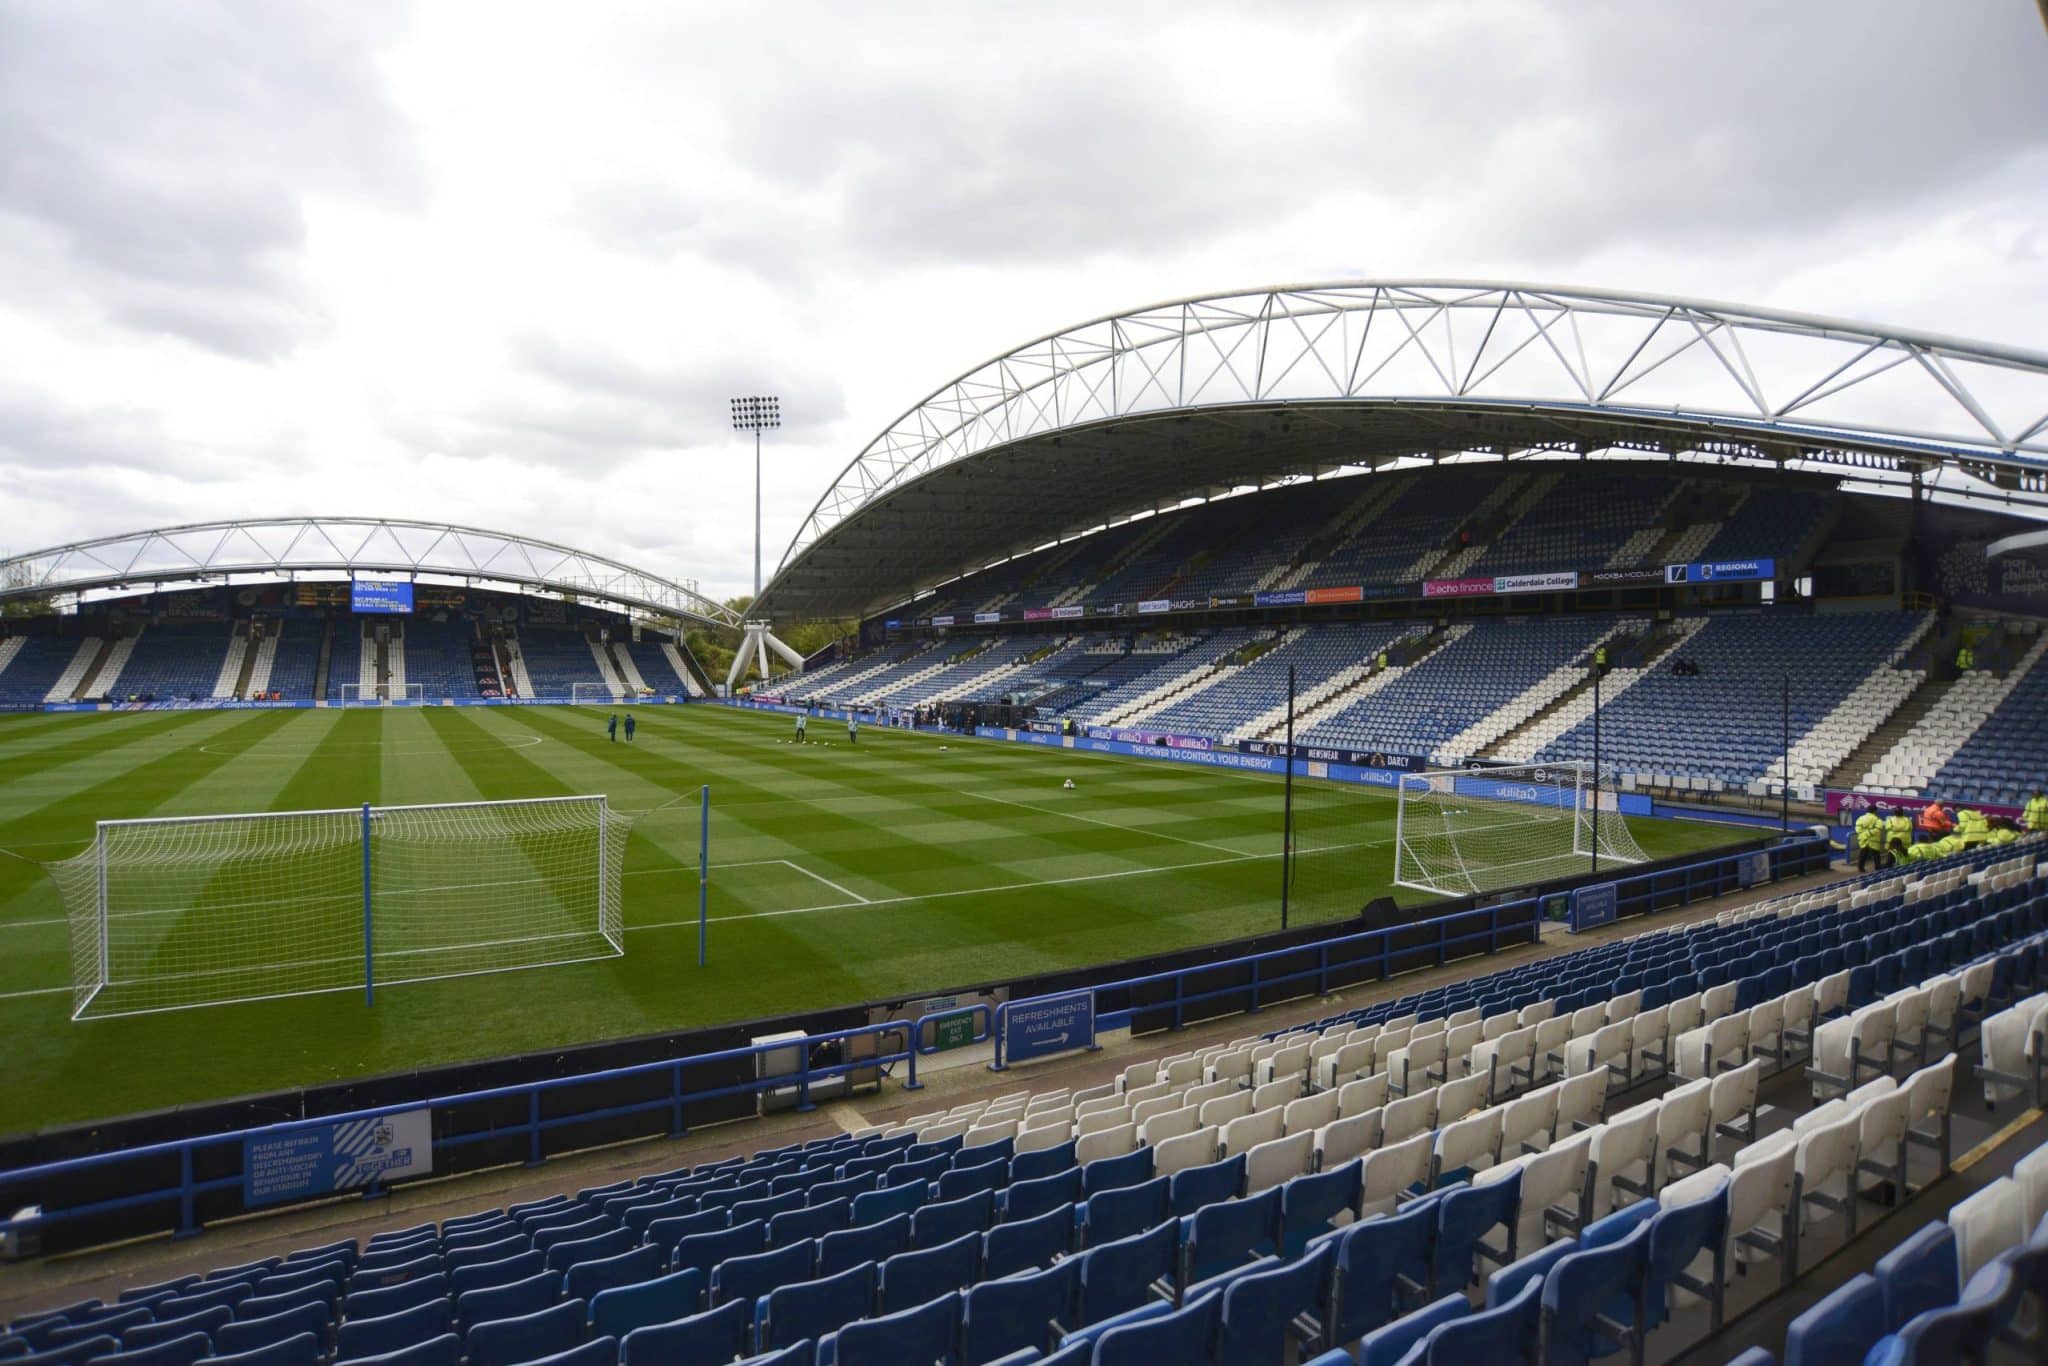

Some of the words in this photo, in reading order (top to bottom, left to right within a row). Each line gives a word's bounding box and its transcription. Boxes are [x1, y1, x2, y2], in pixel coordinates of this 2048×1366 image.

[1715, 562, 1759, 572] REGIONAL
[1436, 583, 1458, 594] echo
[1459, 582, 1493, 593] finance
[1506, 577, 1545, 589] Calderdale
[1546, 576, 1575, 587] College
[1170, 599, 1195, 609] HAIGHS
[1250, 743, 1264, 753] MARC
[1132, 745, 1144, 754] THE
[1145, 746, 1170, 757] POWER
[1170, 749, 1180, 759] TO
[1181, 750, 1216, 763] CONTROL
[1218, 754, 1239, 766] YOUR
[1240, 757, 1273, 769] ENERGY
[1307, 749, 1339, 761] MENSWEAR
[1387, 755, 1409, 767] DARCY
[1360, 771, 1384, 783] utilita
[1496, 787, 1527, 800] utilita
[1012, 1001, 1088, 1023] REFRESHMENTS
[1025, 1015, 1075, 1034] AVAILABLE
[252, 1141, 282, 1152] PLEASE
[252, 1151, 277, 1161] FROM
[277, 1150, 295, 1158] ANY
[252, 1152, 323, 1170] DISCRIMINATORY
[252, 1170, 266, 1178] OR
[266, 1161, 318, 1177] ANTI-SOCIAL
[356, 1155, 411, 1174] TOGETHER
[252, 1173, 301, 1187] BEHAVIOUR
[302, 1170, 312, 1178] IN
[252, 1186, 272, 1196] OUR
[272, 1179, 310, 1193] STADIUM
